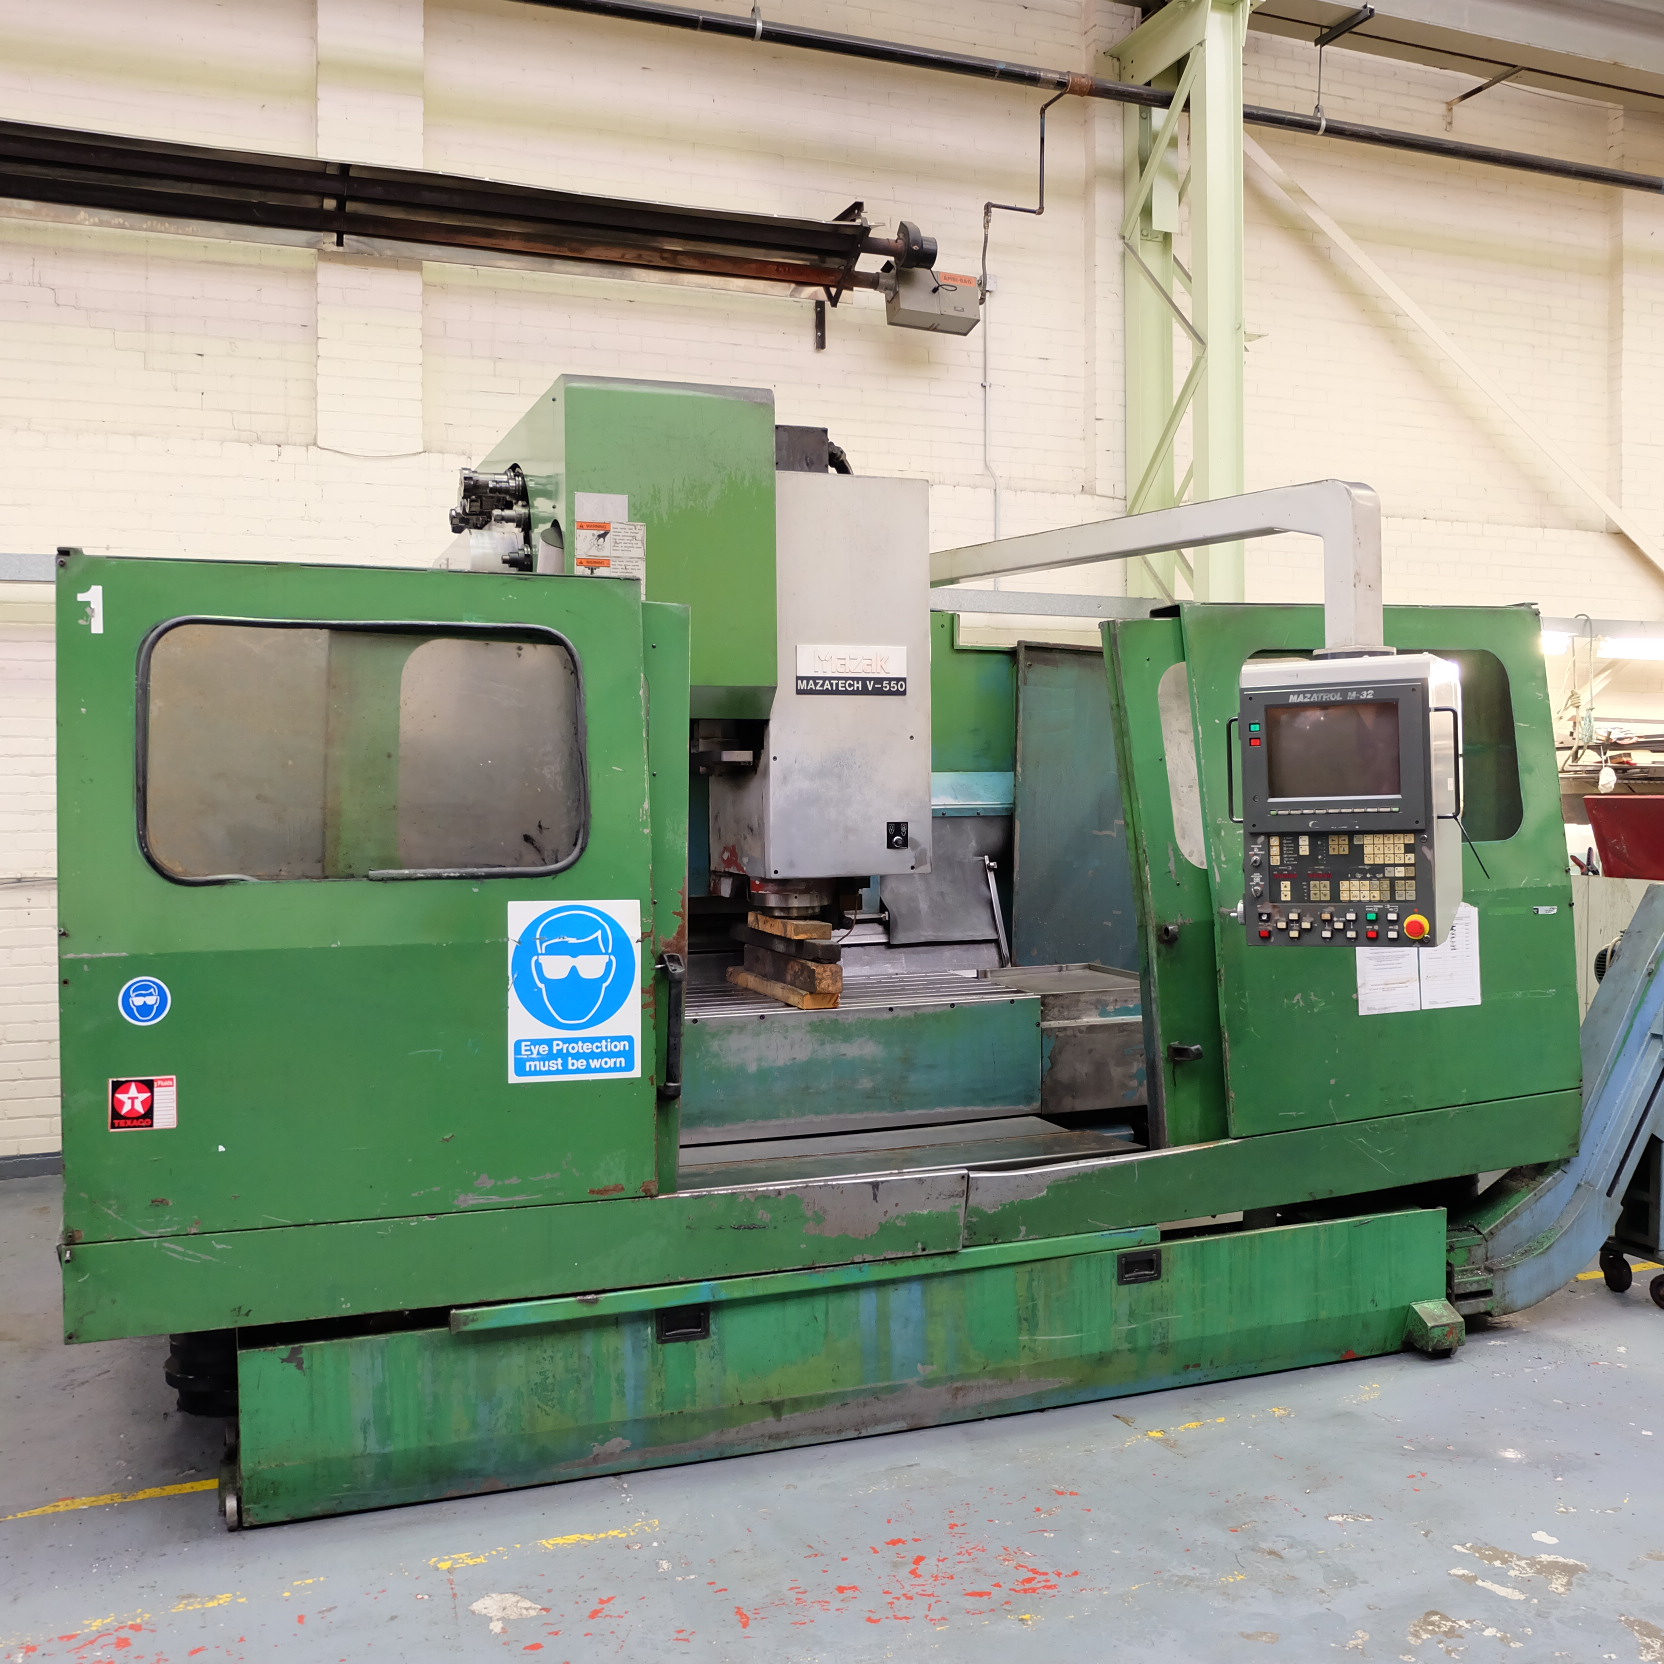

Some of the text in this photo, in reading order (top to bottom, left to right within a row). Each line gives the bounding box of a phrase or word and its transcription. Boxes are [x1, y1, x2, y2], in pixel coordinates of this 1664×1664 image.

[76, 585, 104, 634] 1
[797, 679, 906, 692] MAZATECH V-550
[1288, 689, 1374, 703] MAZATROL M-32
[521, 1039, 629, 1057] Eye Protection
[525, 1057, 626, 1071] must be worn
[113, 1118, 152, 1128] TEXACO
